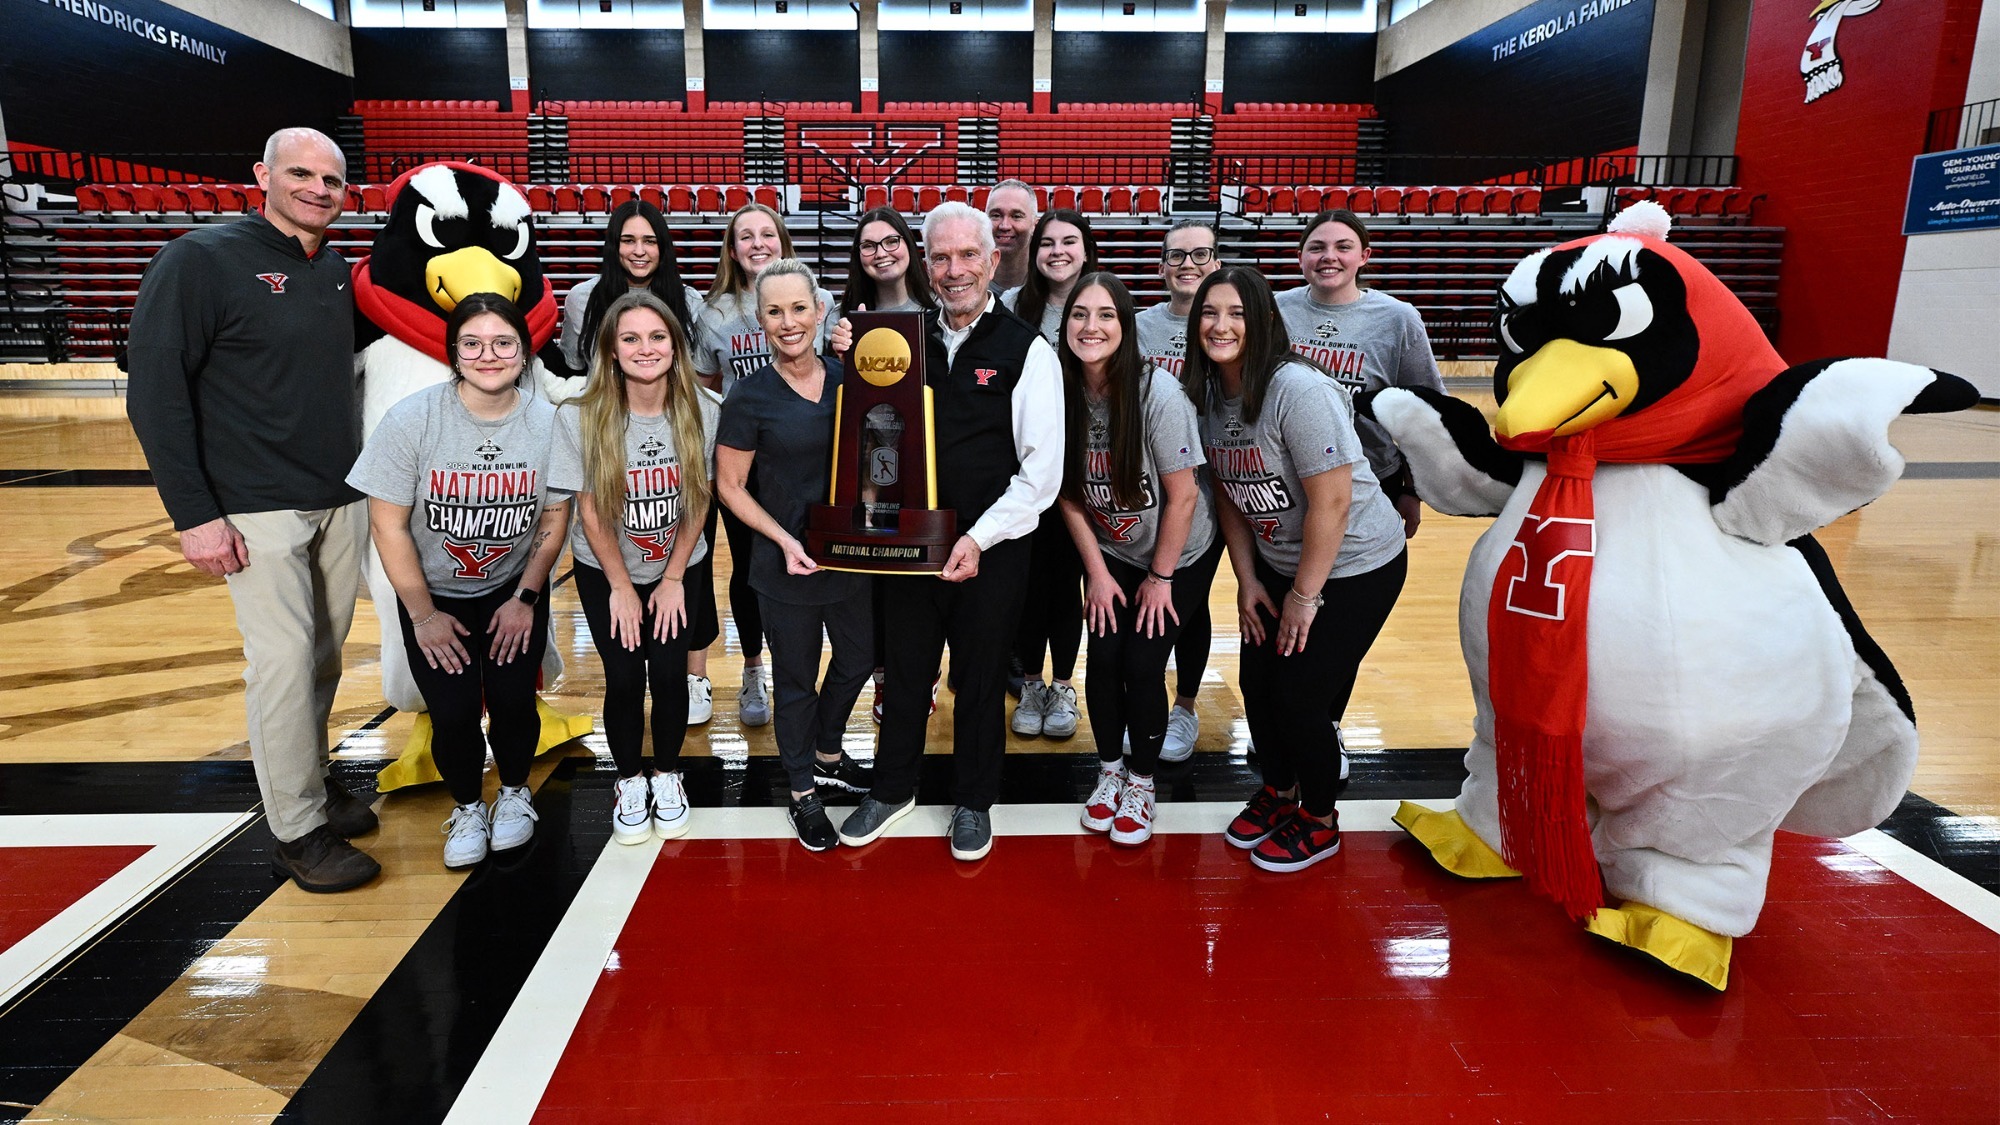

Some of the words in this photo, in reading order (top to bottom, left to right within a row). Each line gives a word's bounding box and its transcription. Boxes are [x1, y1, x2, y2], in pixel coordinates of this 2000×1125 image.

[1492, 37, 1517, 62] THE
[1518, 10, 1576, 51] KEROLA
[1579, 0, 1636, 25] FAMI
[170, 30, 227, 65] FAMILY
[1944, 162, 1996, 175] INSURANCE
[1951, 173, 1985, 183] CANFIELD
[1941, 207, 1985, 216] INSURANCE
[256, 272, 289, 293] Y
[731, 332, 770, 356] NATI
[1309, 339, 1326, 347] NCAA
[858, 356, 908, 373] NCAA
[974, 369, 997, 386] Y
[446, 462, 469, 470] 2025
[495, 461, 527, 470] BOWLING
[637, 459, 656, 467] NCAA
[430, 469, 538, 504] NATIONAL
[428, 503, 536, 539] CHAMPIONS
[1089, 507, 1142, 542] Y
[624, 522, 679, 562] Y
[832, 544, 870, 556] NATIONAL
[872, 546, 920, 558] CHAMPION
[442, 536, 513, 579] Y
[1506, 513, 1597, 621] Y
